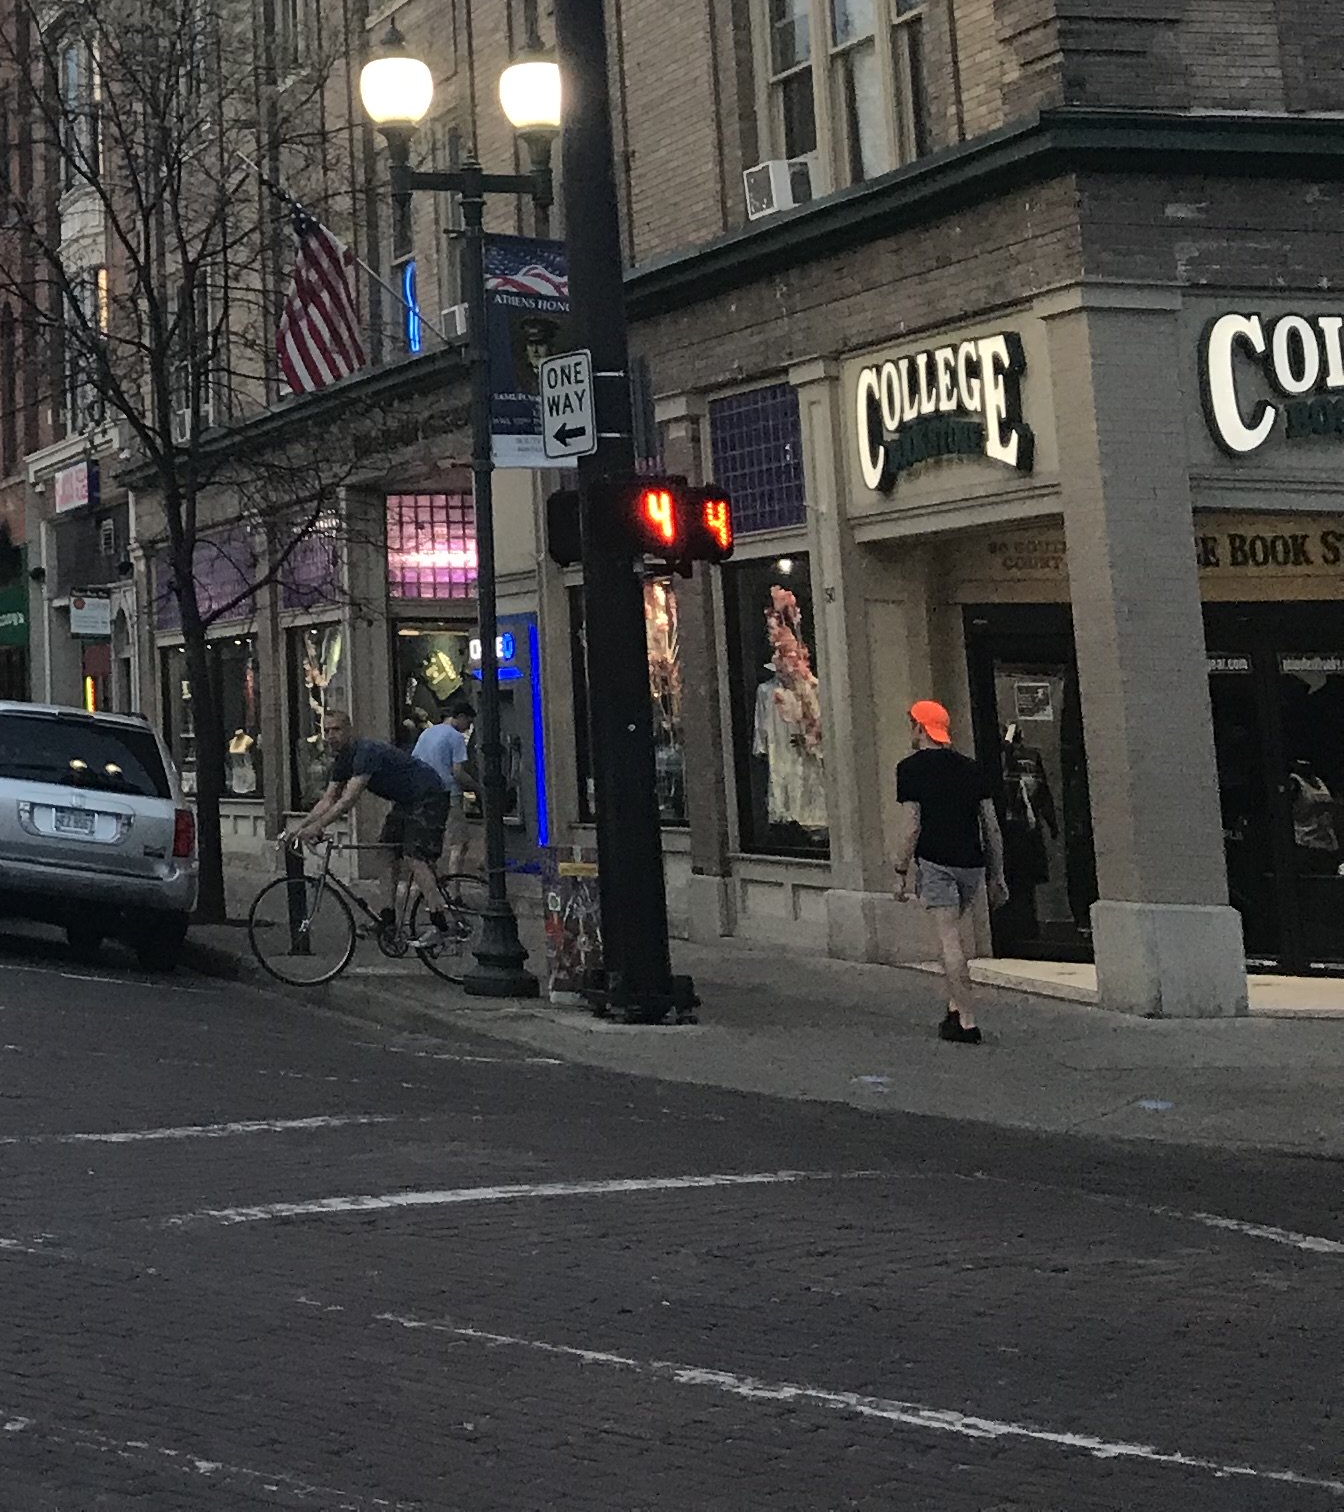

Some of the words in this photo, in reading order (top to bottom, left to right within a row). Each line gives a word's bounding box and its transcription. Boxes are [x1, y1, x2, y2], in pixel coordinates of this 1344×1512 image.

[493, 293, 536, 309] ATHENS
[547, 361, 585, 390] ONE
[547, 389, 586, 417] WAY
[856, 334, 1019, 490] COLLEGE
[645, 490, 674, 540] 4
[704, 499, 728, 547] 4
[1227, 533, 1314, 567] BOOK
[1320, 530, 1344, 566] S
